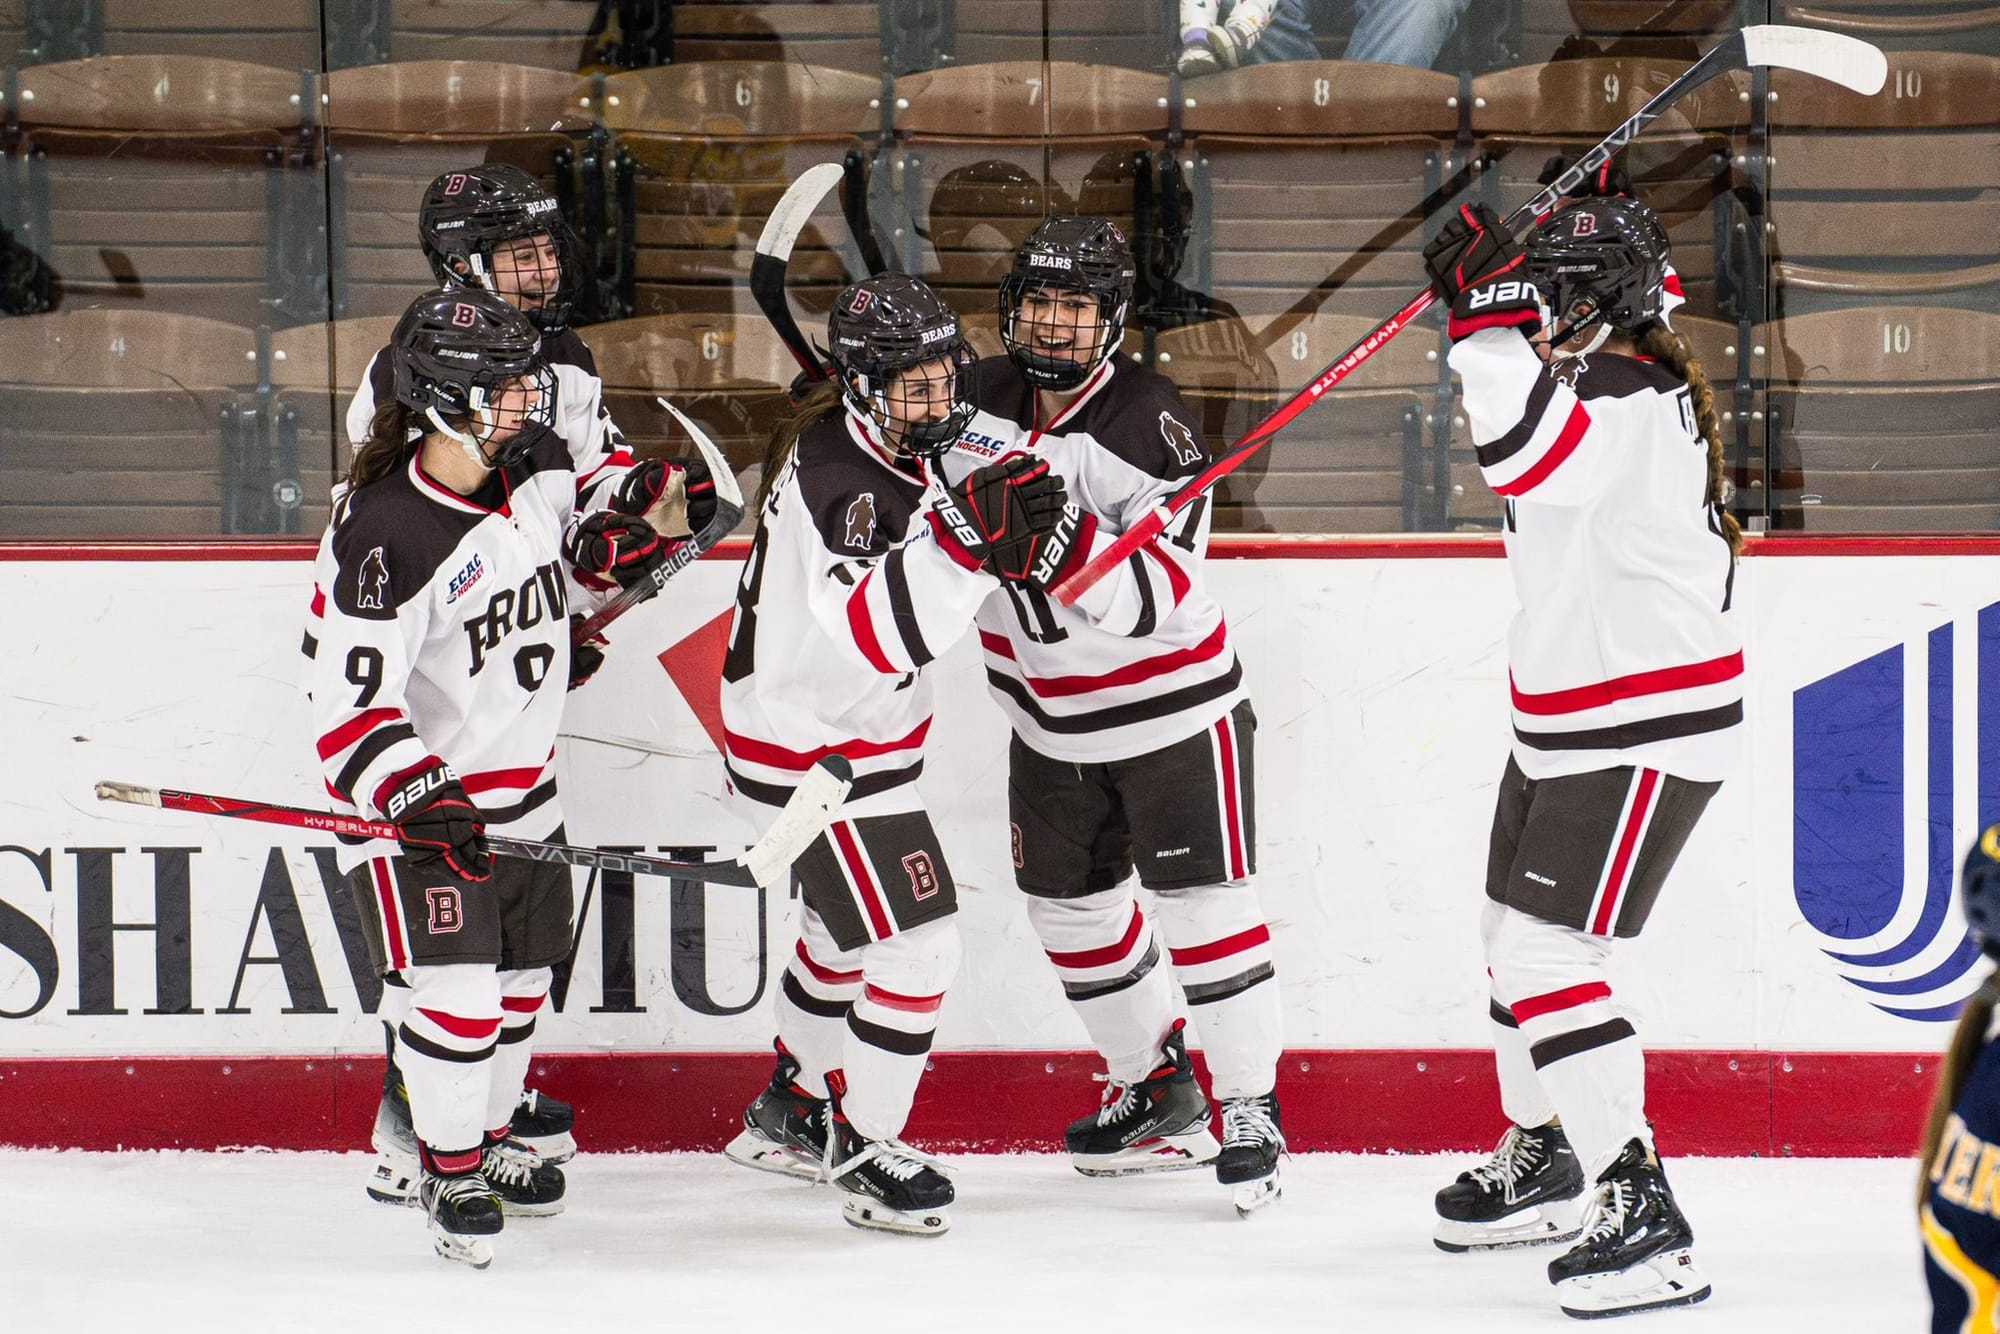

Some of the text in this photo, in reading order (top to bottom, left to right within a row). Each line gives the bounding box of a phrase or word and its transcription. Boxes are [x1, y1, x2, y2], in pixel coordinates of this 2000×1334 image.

[735, 79, 752, 106] 6
[1025, 79, 1042, 106] 7
[1313, 78, 1330, 107] 8
[1603, 73, 1620, 103] 9
[1895, 69, 1922, 99] 10
[444, 174, 468, 196] B
[526, 198, 558, 216] BEARS
[1572, 212, 1597, 237] B
[1029, 254, 1073, 271] BEARS
[452, 302, 476, 328] B
[849, 288, 872, 315] B
[702, 331, 719, 360] 6
[920, 323, 957, 346] BEARS
[1291, 331, 1308, 360] 8
[1883, 323, 1911, 353] 10
[955, 441, 998, 458] HOCKEY
[448, 552, 482, 594] ECAC
[650, 539, 702, 587] BAUER
[457, 564, 485, 598] HOCKEY
[344, 645, 384, 708] 9
[1156, 847, 1191, 858] BAUER
[901, 850, 940, 902] B
[425, 886, 464, 935] B
[1120, 1118, 1158, 1145] BAUER
[854, 1171, 886, 1198] BAUER
